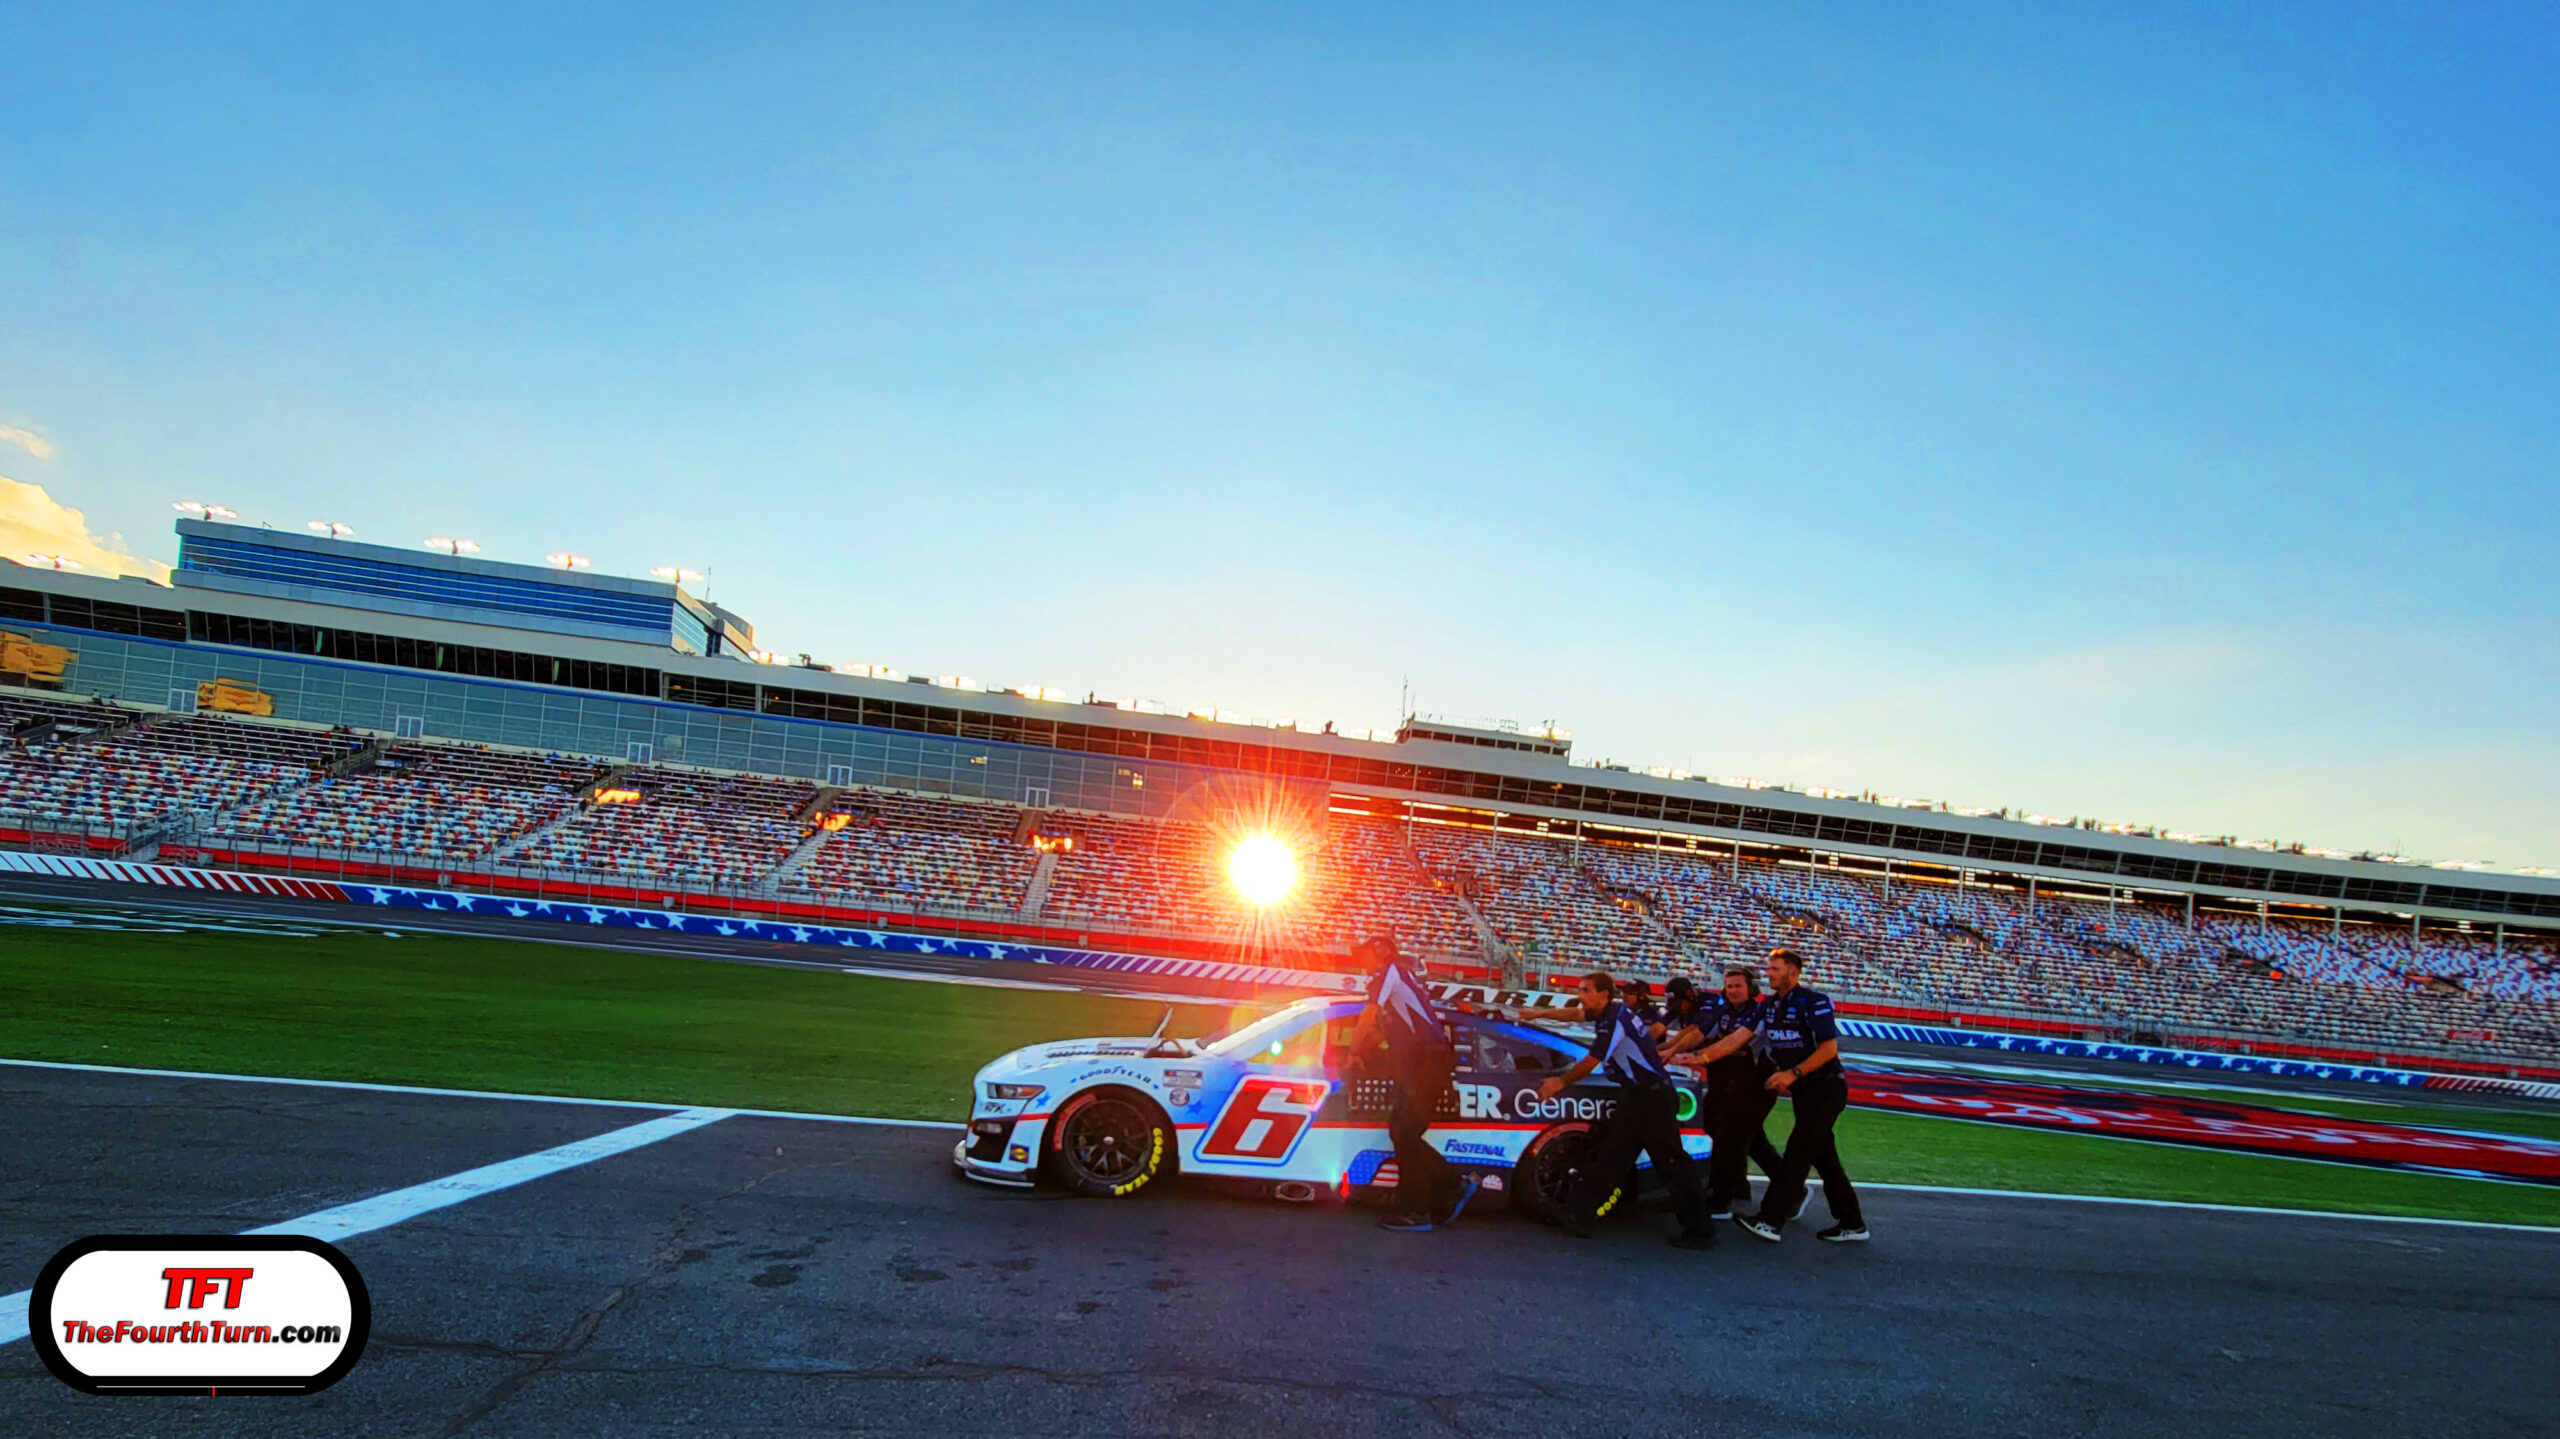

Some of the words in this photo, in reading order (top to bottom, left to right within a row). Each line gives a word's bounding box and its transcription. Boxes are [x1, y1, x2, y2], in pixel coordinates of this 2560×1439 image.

[1201, 1078, 1329, 1160] 6
[1514, 1087, 1618, 1121] Genera
[1444, 1138, 1505, 1158] FASTENAL
